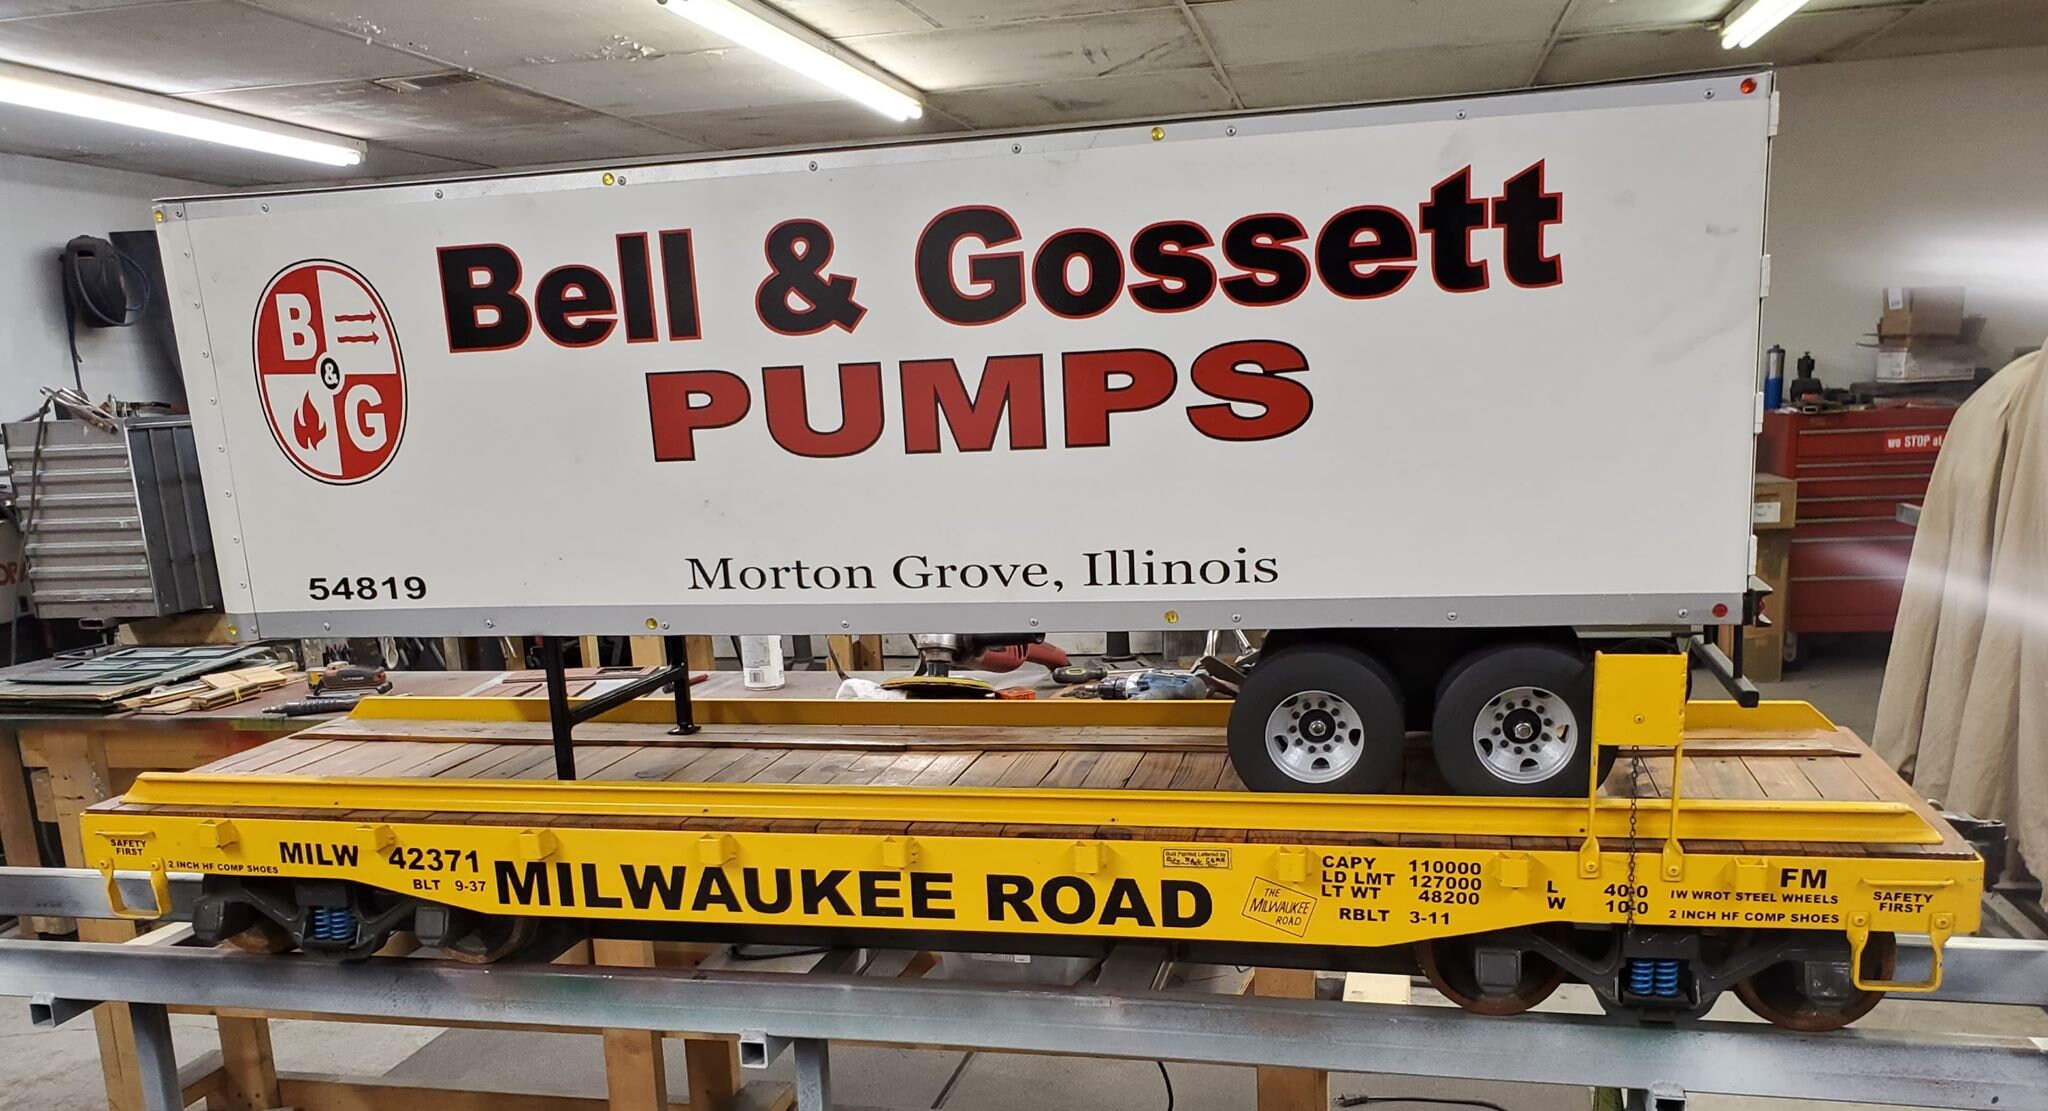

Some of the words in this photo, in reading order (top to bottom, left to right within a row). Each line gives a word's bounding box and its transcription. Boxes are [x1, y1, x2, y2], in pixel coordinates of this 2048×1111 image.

[436, 229, 701, 353] Bell
[755, 218, 867, 336] &
[915, 158, 1563, 326] Gossett
[275, 293, 318, 361] B
[324, 362, 339, 386] &
[344, 384, 387, 452] G
[645, 339, 1313, 463] PUMPS
[1904, 434, 1931, 448] STOP
[685, 557, 876, 590] Morton
[893, 555, 1064, 593] Grove,
[1082, 547, 1279, 586] Illinois
[308, 577, 427, 601] 54819
[110, 838, 147, 848] SAFETY
[116, 847, 143, 856] FIRST
[279, 841, 359, 868] MILW
[388, 846, 479, 873] 42371
[168, 860, 174, 869] 2
[177, 861, 200, 870] INCH
[203, 862, 214, 871] HF
[218, 863, 244, 872] COMP
[247, 864, 279, 874] SHOES
[1322, 855, 1377, 870] CAPY
[1409, 859, 1482, 875] 110000
[413, 878, 441, 891] BLT
[455, 879, 487, 892] 9-37
[1322, 870, 1347, 883] LD
[1354, 872, 1396, 886] LMT
[1409, 875, 1482, 891] 127000
[1780, 867, 1828, 889] FM
[1264, 888, 1281, 898] THE
[1547, 880, 1559, 893] L
[494, 860, 956, 920] MILWAUKEE
[986, 874, 1213, 929] ROAD
[1321, 884, 1344, 897] LT
[1351, 886, 1381, 899] WT
[1418, 890, 1480, 905] 48200
[1692, 890, 1731, 901] WROT
[1735, 891, 1777, 903] STEEL
[1782, 893, 1839, 905] WHEELS
[1873, 891, 1934, 904] SAFETY
[1249, 898, 1311, 914] MILWAUKEE
[1547, 896, 1567, 910] W
[1879, 902, 1925, 914] FIRST
[1276, 916, 1302, 926] ROAD
[1339, 907, 1391, 922] RBLT
[1409, 911, 1450, 925] 3-11
[1669, 909, 1677, 919] 2
[1681, 910, 1716, 920] INCH
[1721, 911, 1740, 921] HF
[1745, 912, 1786, 922] COMP
[1791, 913, 1840, 924] SHOES
